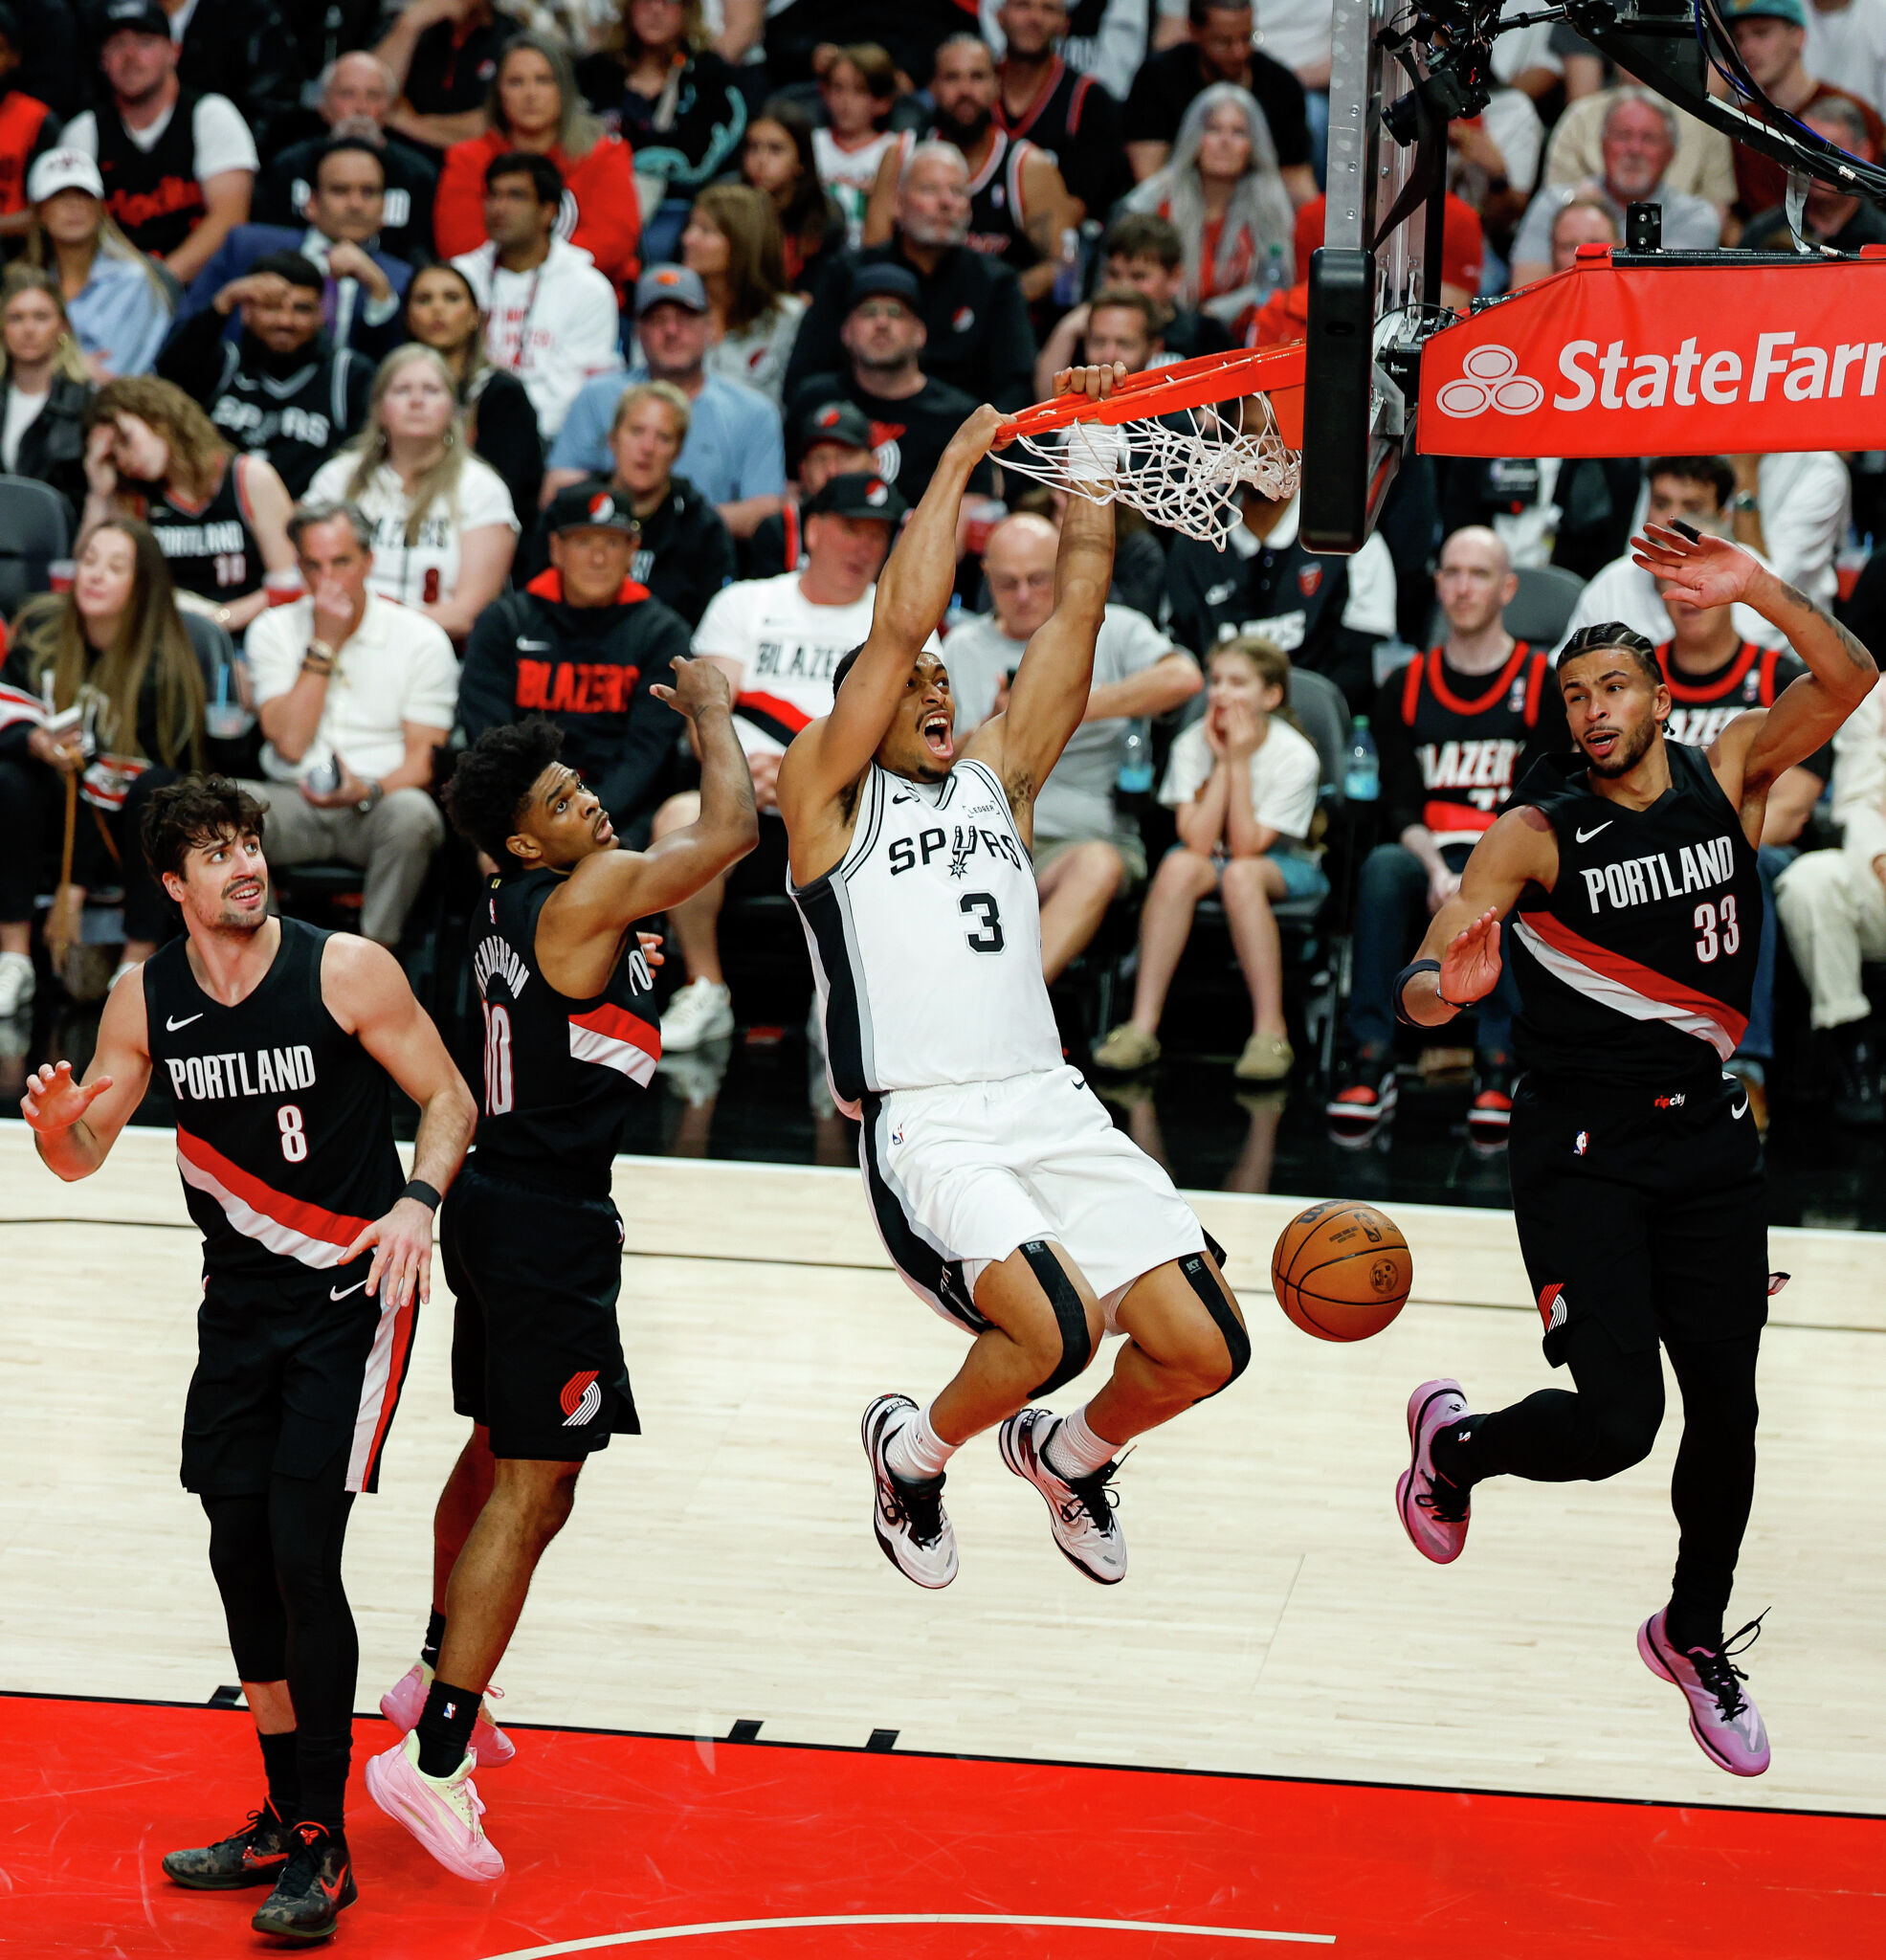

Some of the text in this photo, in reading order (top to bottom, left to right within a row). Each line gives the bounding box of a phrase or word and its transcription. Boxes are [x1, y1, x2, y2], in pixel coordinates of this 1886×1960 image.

[516, 657, 640, 713] BLAZERS
[1413, 738, 1527, 791] LAZER
[888, 825, 1022, 880] SPURS
[1579, 835, 1735, 914] PORTLAND
[958, 889, 1007, 955] 3
[1693, 893, 1741, 964] 33
[164, 1044, 317, 1101] PORTLAND
[277, 1103, 310, 1164] 8
